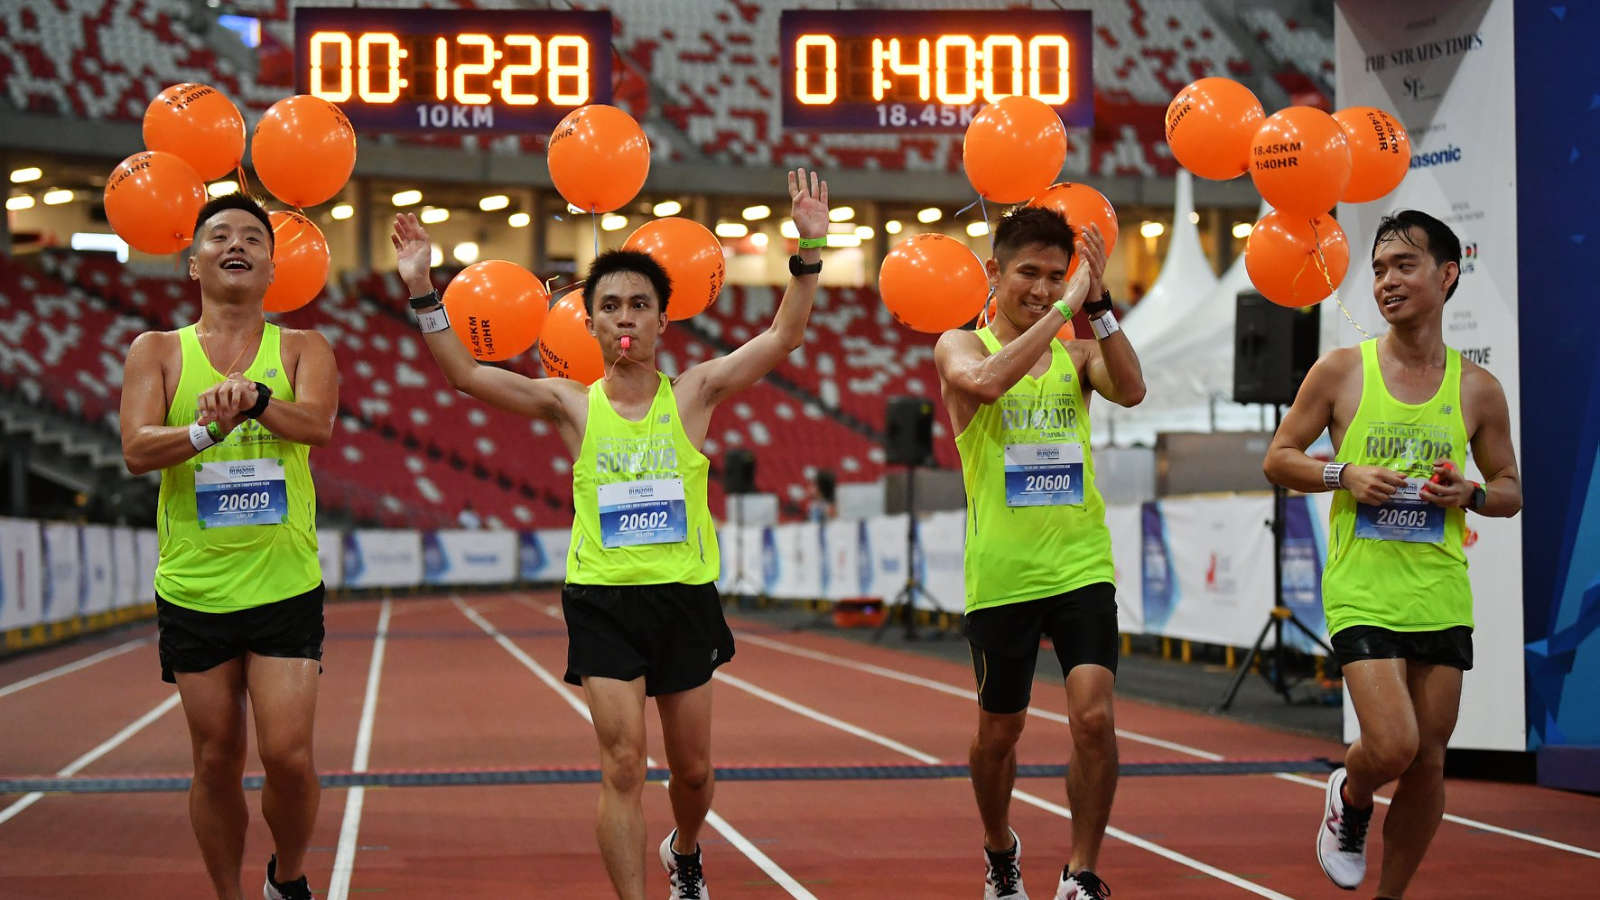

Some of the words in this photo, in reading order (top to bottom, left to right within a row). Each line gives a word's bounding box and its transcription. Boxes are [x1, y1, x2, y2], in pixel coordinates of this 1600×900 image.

[310, 32, 589, 106] 00:12:28
[416, 105, 494, 127] 10KM
[876, 104, 986, 126] 18.45K
[1367, 112, 1388, 152] 1:40HR
[1254, 142, 1302, 156] 18.45KM
[1410, 144, 1461, 169] asonic
[1255, 156, 1299, 170] 1:40HR
[481, 319, 496, 355] 1:40HR
[1025, 474, 1070, 491] 20600
[218, 491, 270, 512] 20609
[619, 511, 668, 531] 20602
[1377, 509, 1427, 526] 20603
